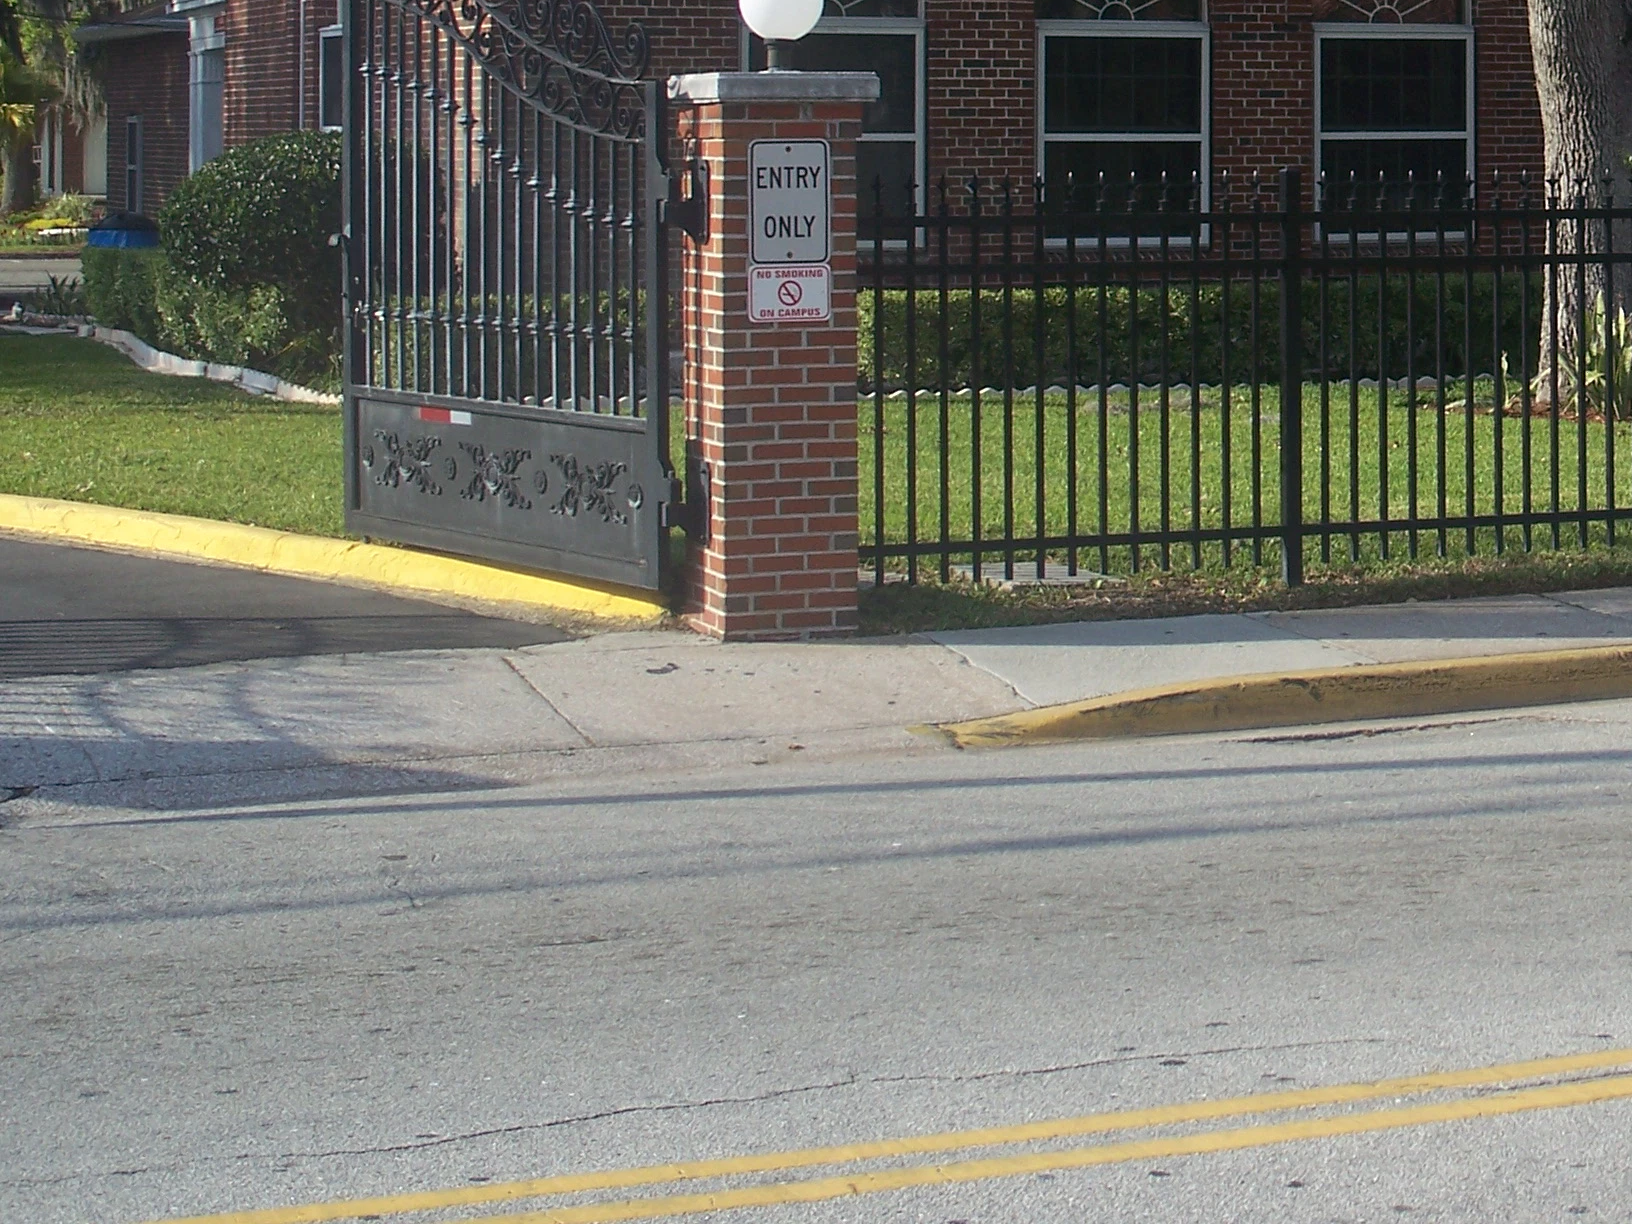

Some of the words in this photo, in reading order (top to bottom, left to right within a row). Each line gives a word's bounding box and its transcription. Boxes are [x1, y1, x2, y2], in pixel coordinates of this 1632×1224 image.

[756, 166, 821, 189] ENTRY
[764, 215, 816, 238] ONLY
[757, 270, 772, 279] NO
[775, 269, 824, 278] SMOKING
[760, 309, 775, 317] ON
[778, 307, 821, 317] CAMPUS
